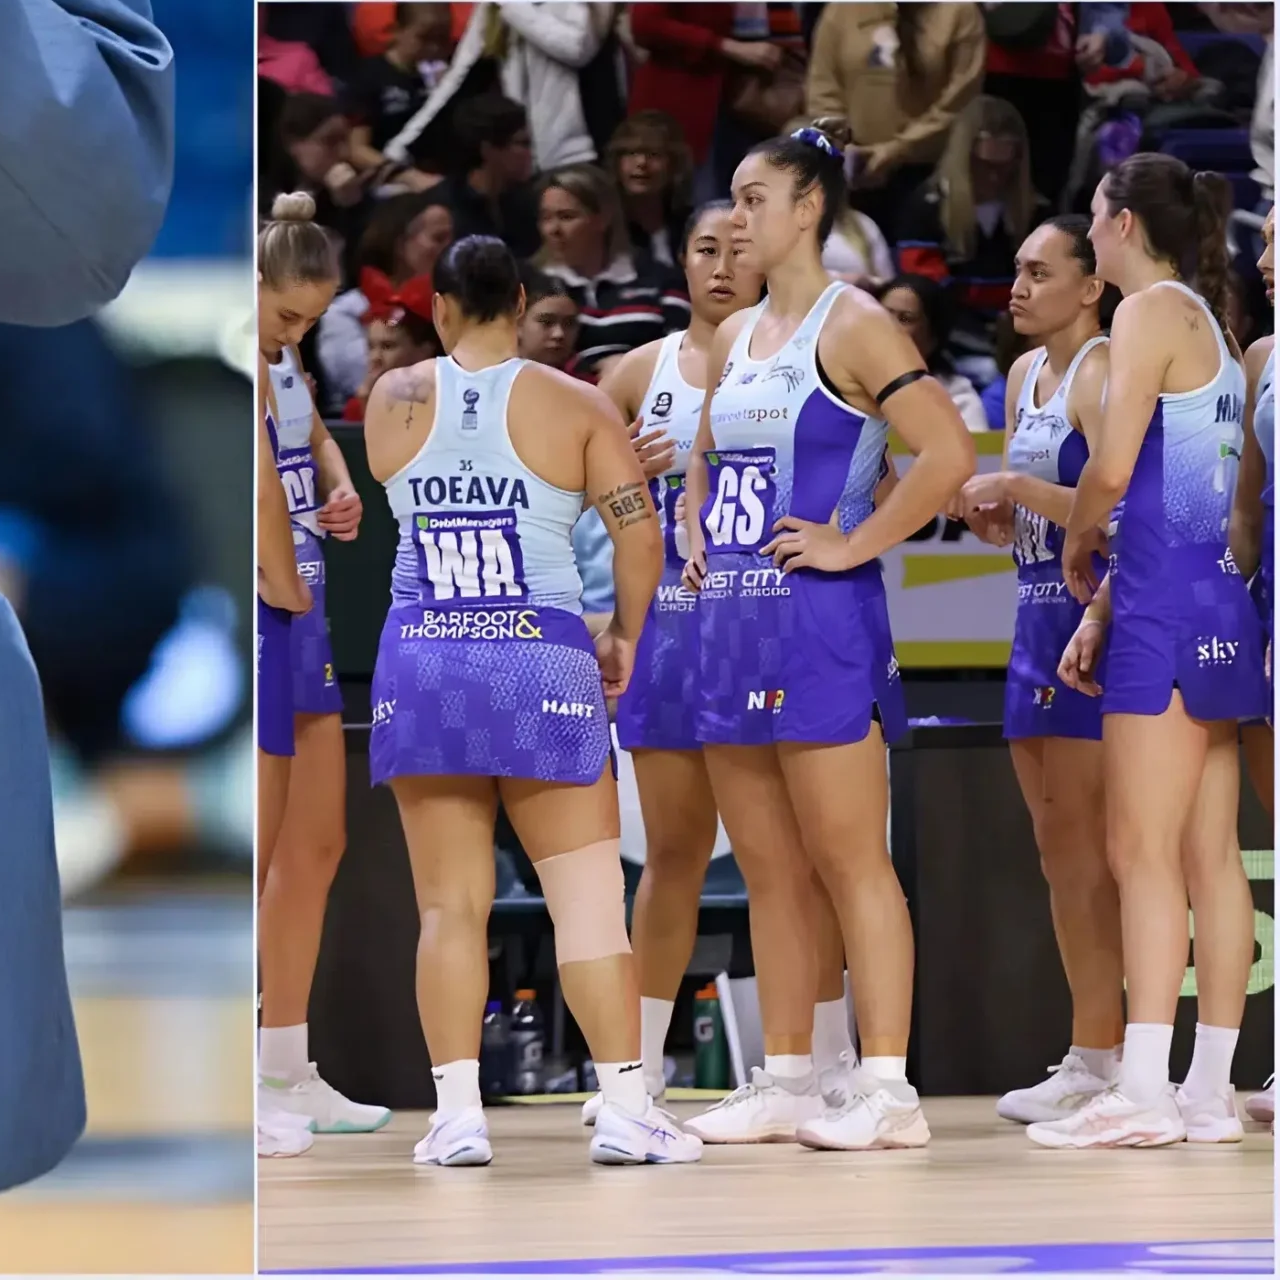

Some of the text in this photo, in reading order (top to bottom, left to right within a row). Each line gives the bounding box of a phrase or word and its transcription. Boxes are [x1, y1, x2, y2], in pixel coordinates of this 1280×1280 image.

[408, 476, 530, 509] TOEAVA
[705, 465, 767, 546] GS
[419, 529, 523, 600] WA
[424, 610, 518, 627] BARFOOT
[400, 624, 514, 640] THOMPSON
[1197, 635, 1239, 660] sky
[542, 699, 595, 718] HART
